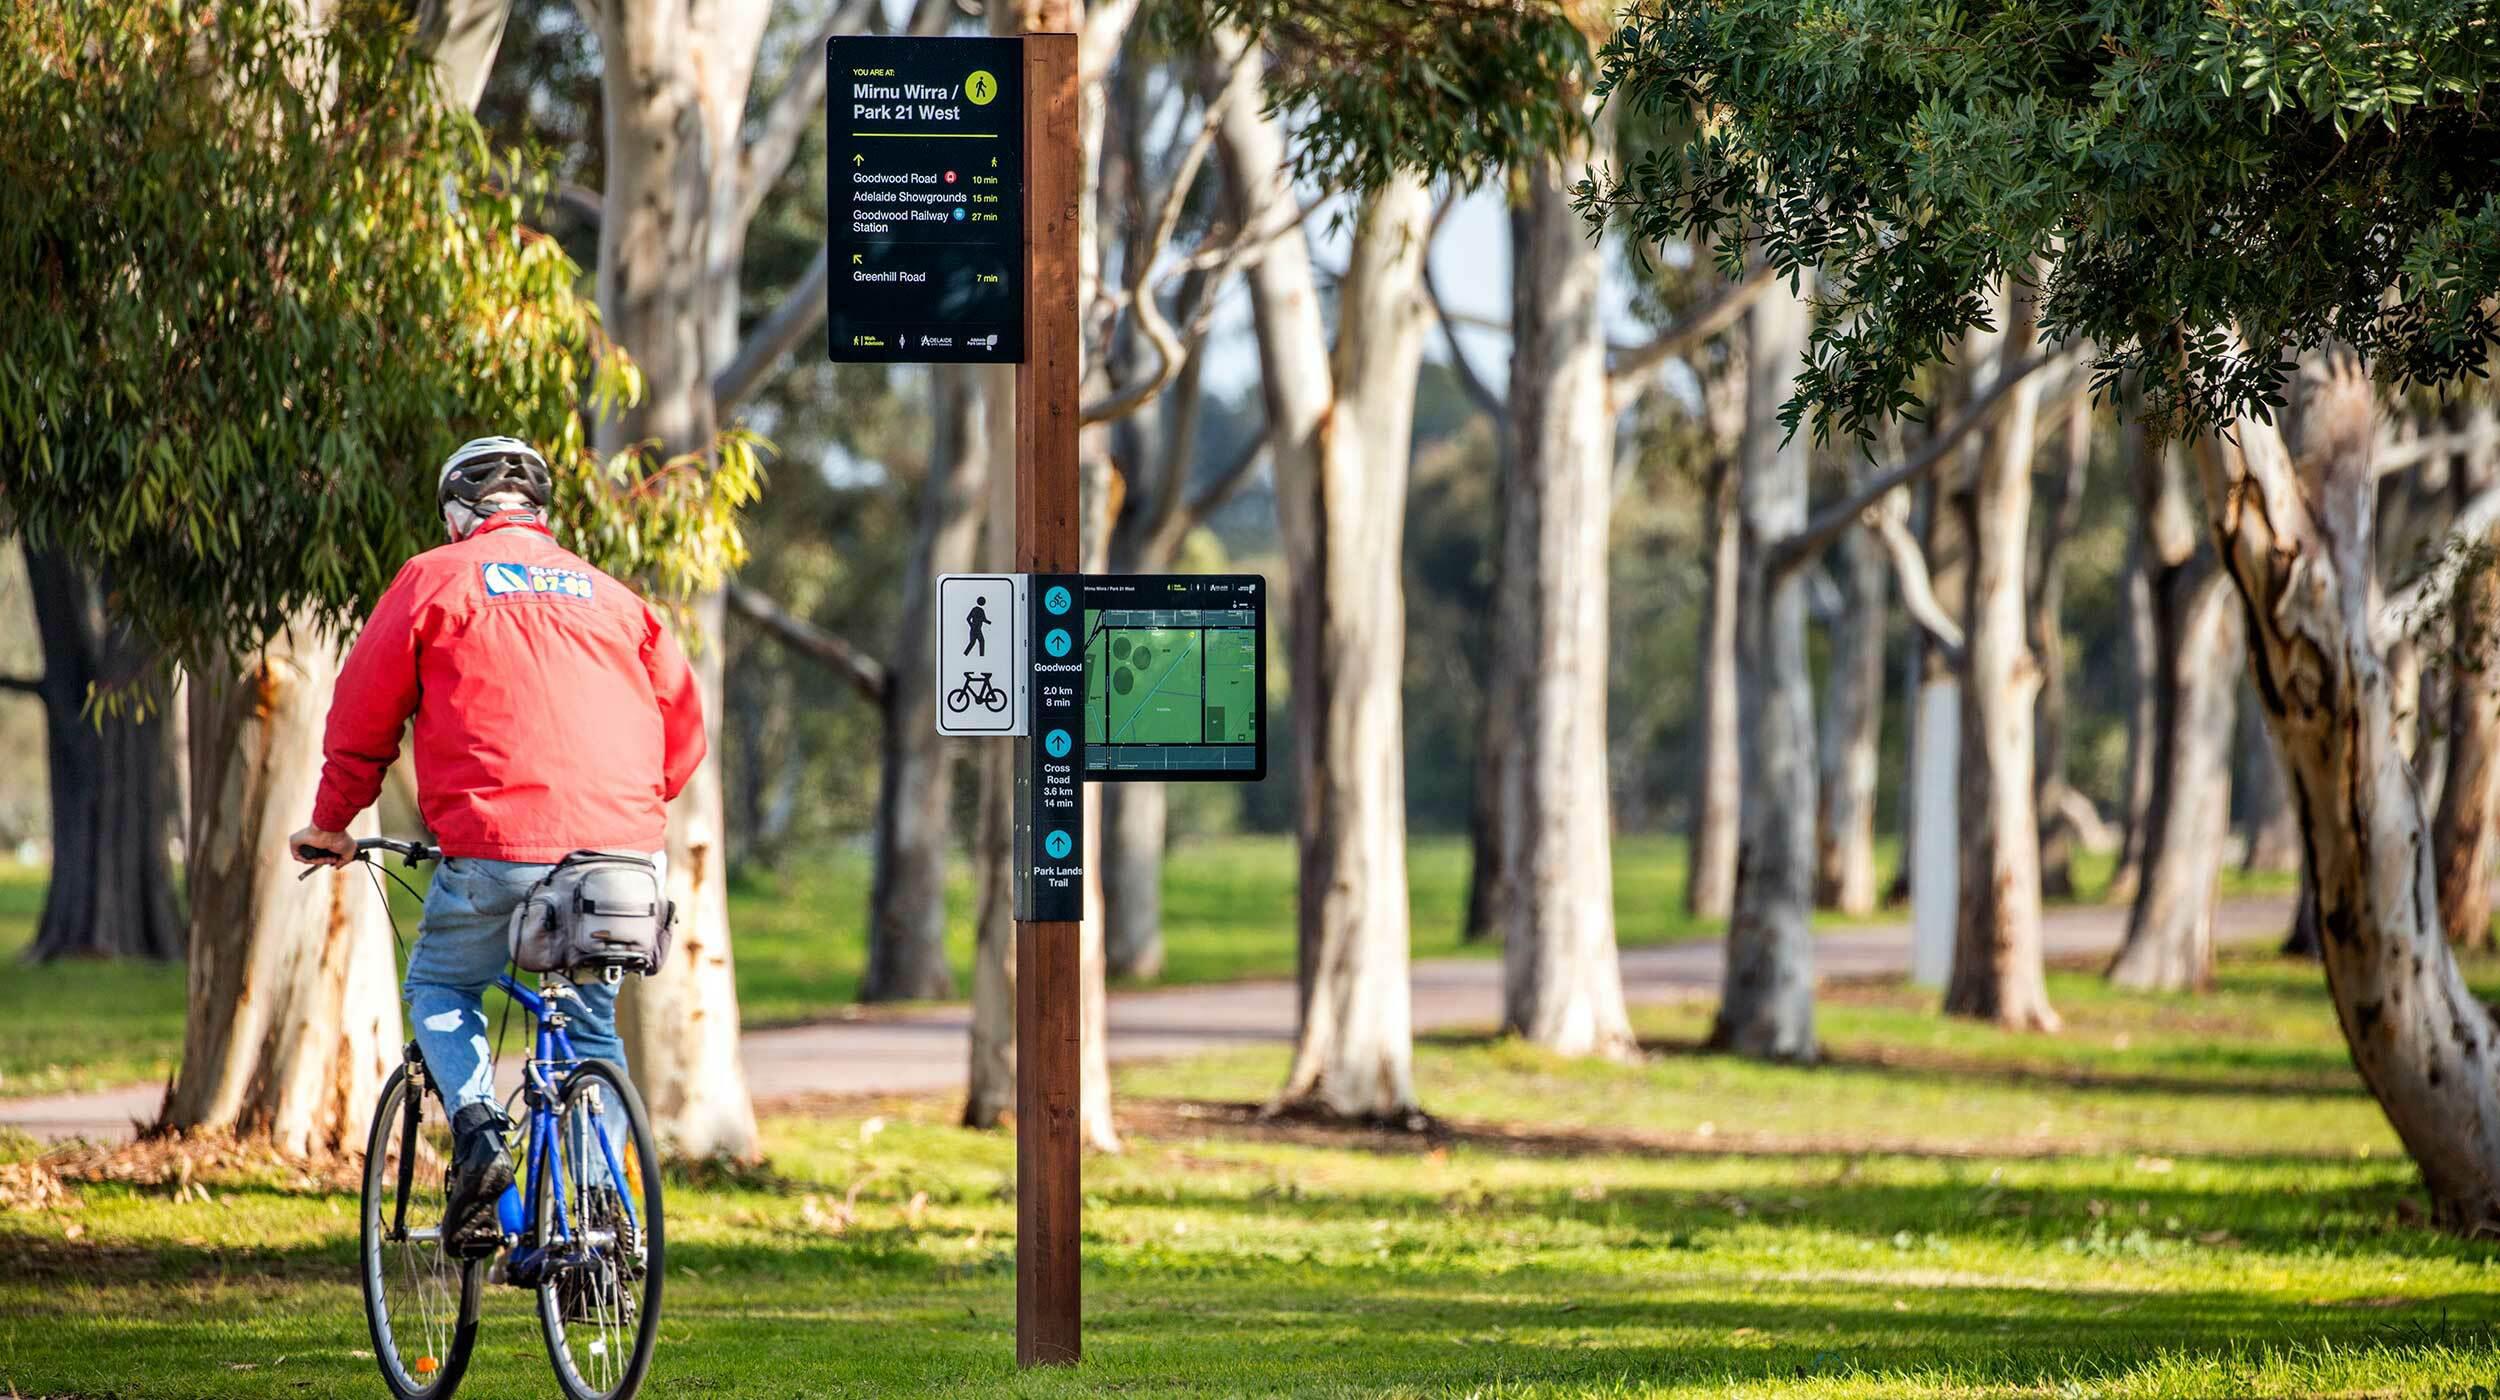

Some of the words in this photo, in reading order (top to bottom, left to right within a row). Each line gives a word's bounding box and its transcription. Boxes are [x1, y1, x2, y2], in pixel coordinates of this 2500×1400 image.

[853, 84, 900, 99] Mirnu
[904, 84, 948, 100] Wirra
[951, 84, 959, 100] /
[853, 104, 892, 120] Park
[895, 105, 913, 120] 21
[918, 105, 960, 120] West
[853, 173, 909, 184] Goodwood
[911, 173, 937, 184] Road
[972, 176, 983, 184] 10
[983, 176, 998, 184] min
[853, 191, 897, 202] Adelaide
[899, 192, 967, 204] Showgrounds
[853, 210, 909, 221] Goodwood
[911, 210, 949, 223] Railway
[972, 213, 982, 221] 27
[983, 213, 998, 221] min
[853, 222, 889, 232] Station
[853, 271, 897, 282] Greenhill
[899, 271, 926, 282] Road
[1034, 663, 1083, 672] Goodwood
[1044, 687, 1057, 695] 2.0
[1059, 687, 1073, 695] km
[1046, 698, 1052, 707] 8
[1054, 698, 1071, 707] min
[1044, 764, 1070, 773] Cross
[1047, 775, 1070, 784] Road
[1044, 787, 1058, 796] 3.6
[1059, 787, 1073, 796] km
[1044, 799, 1055, 807] 14
[1056, 799, 1073, 807] min
[1034, 867, 1055, 876] Park
[1056, 867, 1083, 876] Lands
[1049, 879, 1069, 887] Trail
